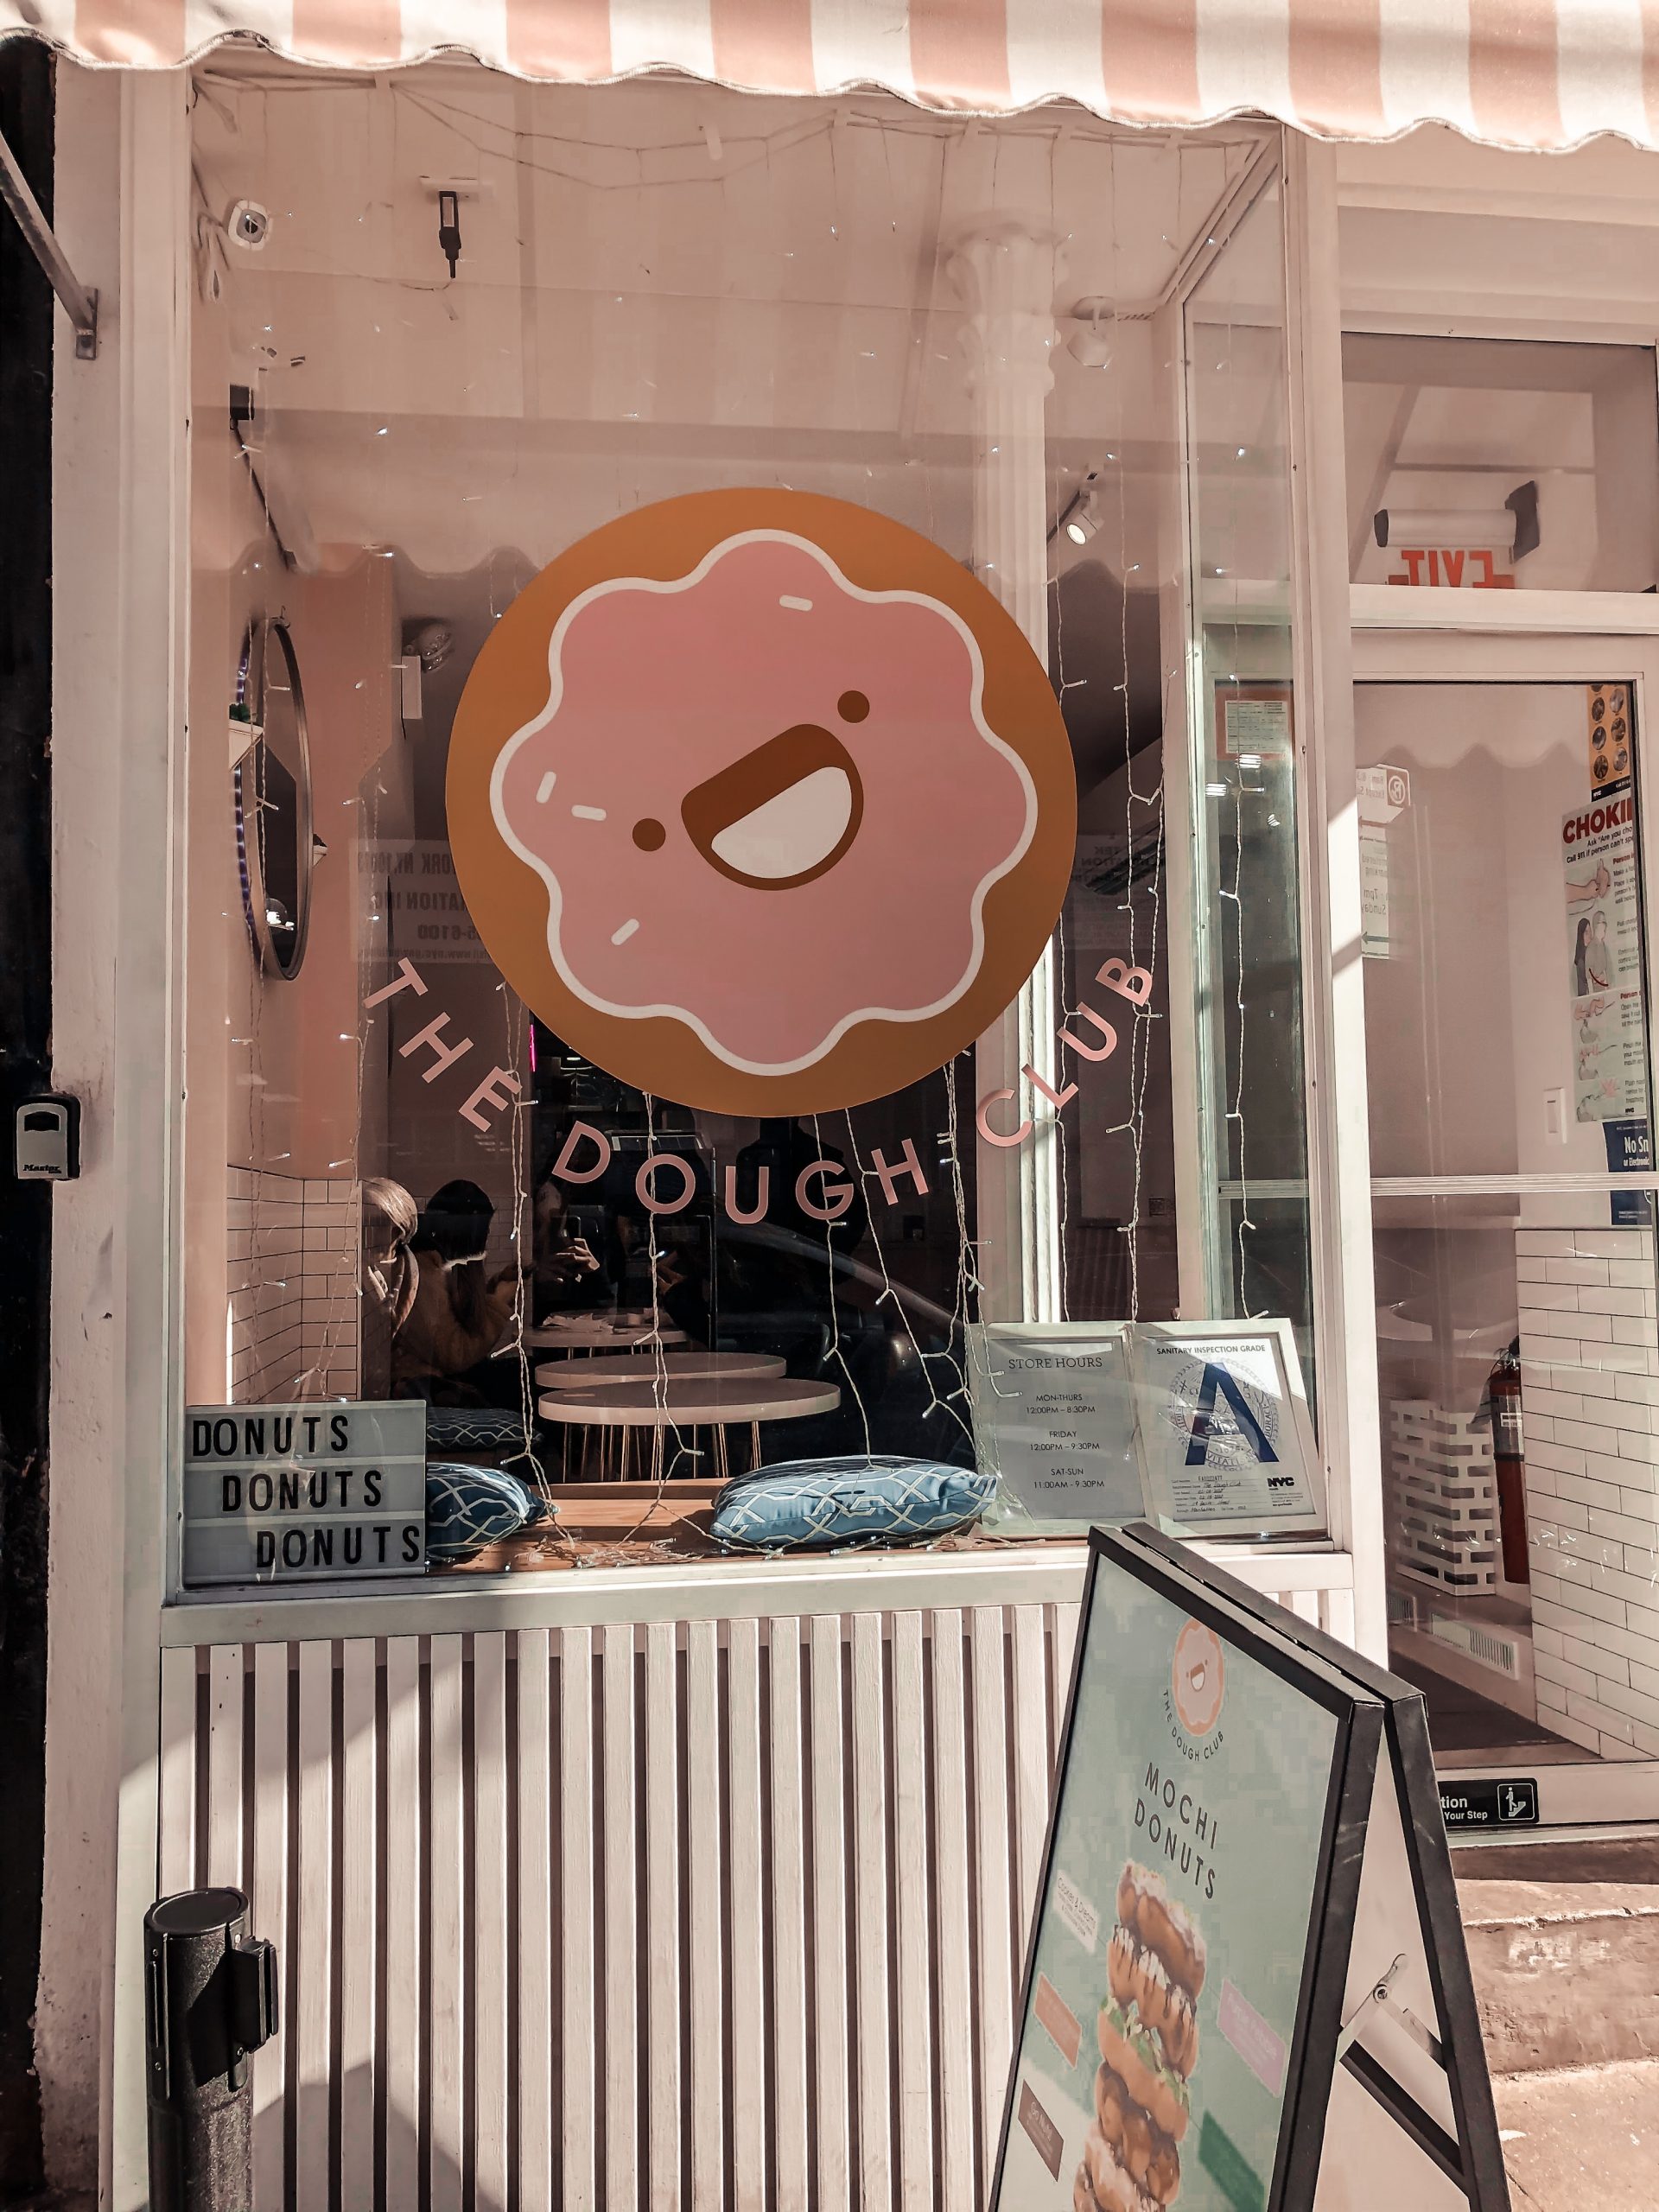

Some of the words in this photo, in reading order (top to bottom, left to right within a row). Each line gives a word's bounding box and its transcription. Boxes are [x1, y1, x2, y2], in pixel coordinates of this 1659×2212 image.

[1566, 855, 1577, 864] Call
[1577, 852, 1586, 861] 911
[1591, 842, 1610, 857] person
[362, 957, 523, 1133] THE
[551, 1121, 929, 1224] DOUGH
[976, 957, 1153, 1147] CLUB
[1624, 1136, 1637, 1154] No
[1008, 1357, 1052, 1369] STORE
[1055, 1357, 1103, 1368] HOURS
[1156, 1346, 1192, 1355] SANITARY
[1194, 1345, 1238, 1354] INSPECTION
[1026, 1406, 1058, 1414] 12:00PM
[1185, 1362, 1280, 1466] A
[193, 1414, 348, 1457] DONUTS
[222, 1470, 382, 1512] DONUTS
[1033, 1480, 1069, 1489] 11:00AM
[1267, 1477, 1295, 1487] NYC
[257, 1525, 420, 1568] DONUTS
[1163, 1688, 1173, 1723] THE
[1172, 1726, 1199, 1762] DOUGH
[1204, 1730, 1224, 1760] CLUB
[1144, 1762, 1217, 1850] MOCHI
[1444, 1811, 1465, 1821] Your
[1466, 1810, 1488, 1821] Step
[1134, 1797, 1216, 1899] DONUTS
